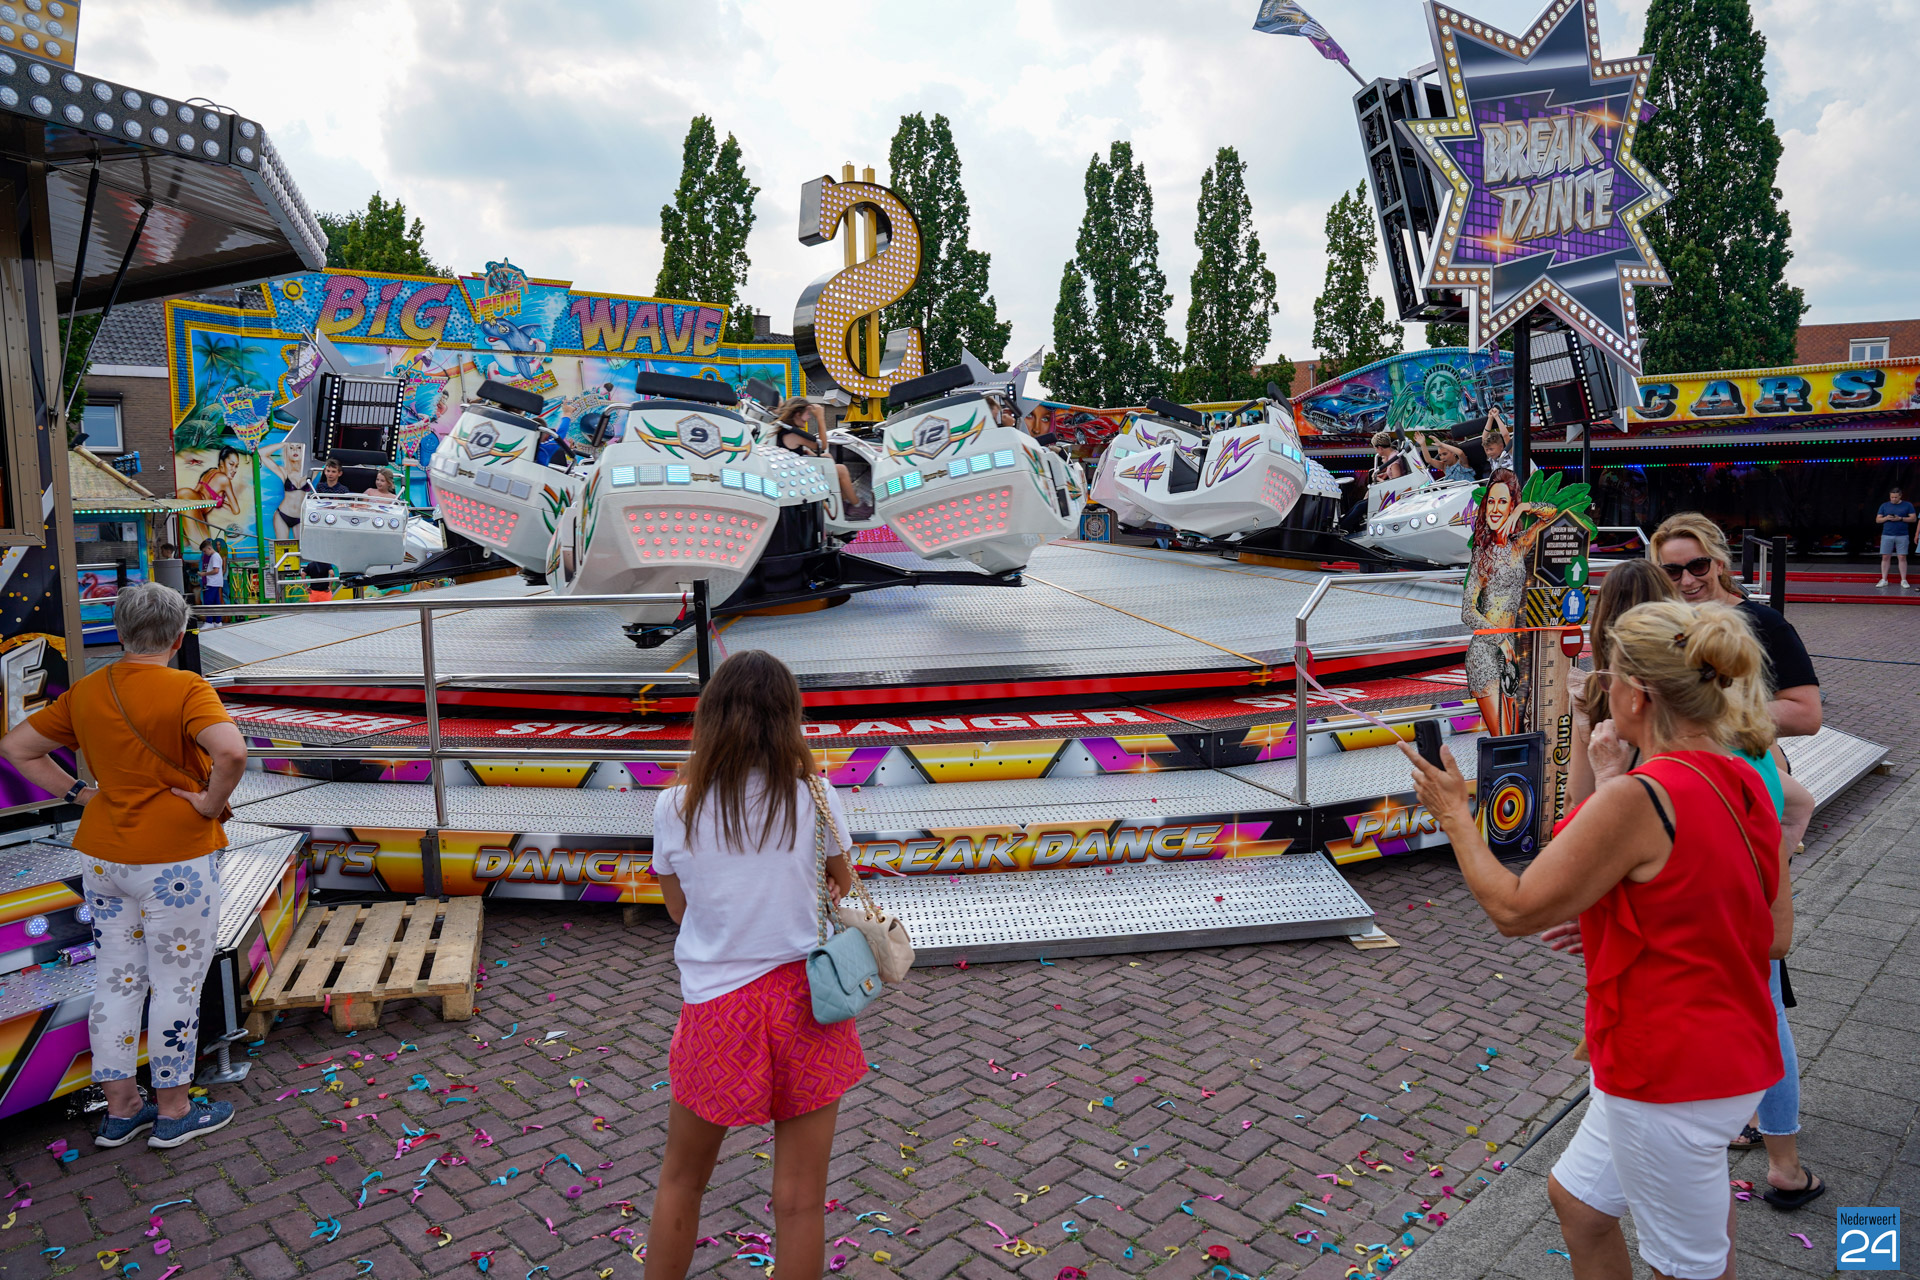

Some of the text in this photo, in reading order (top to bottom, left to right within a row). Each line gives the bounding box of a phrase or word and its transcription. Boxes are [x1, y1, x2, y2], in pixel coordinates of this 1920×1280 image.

[1479, 112, 1604, 186] BREAK
[1490, 168, 1614, 242] DANCE
[479, 292, 519, 320] FUN
[570, 296, 724, 356] WAVE
[1632, 369, 1886, 420] CARS
[690, 427, 708, 443] 9
[918, 424, 945, 446] 12
[1789, 410, 1905, 430] SCOOTER
[471, 431, 493, 447] 10
[1233, 688, 1369, 708] STOP
[221, 702, 412, 731] ANGER
[495, 722, 666, 737] STOP
[801, 710, 1151, 737] DANGER
[1553, 714, 1571, 766] CLUB
[1351, 804, 1440, 847] PAR
[304, 841, 379, 876] T'S
[1032, 824, 1224, 869] DANCE
[472, 847, 655, 884] DANCE
